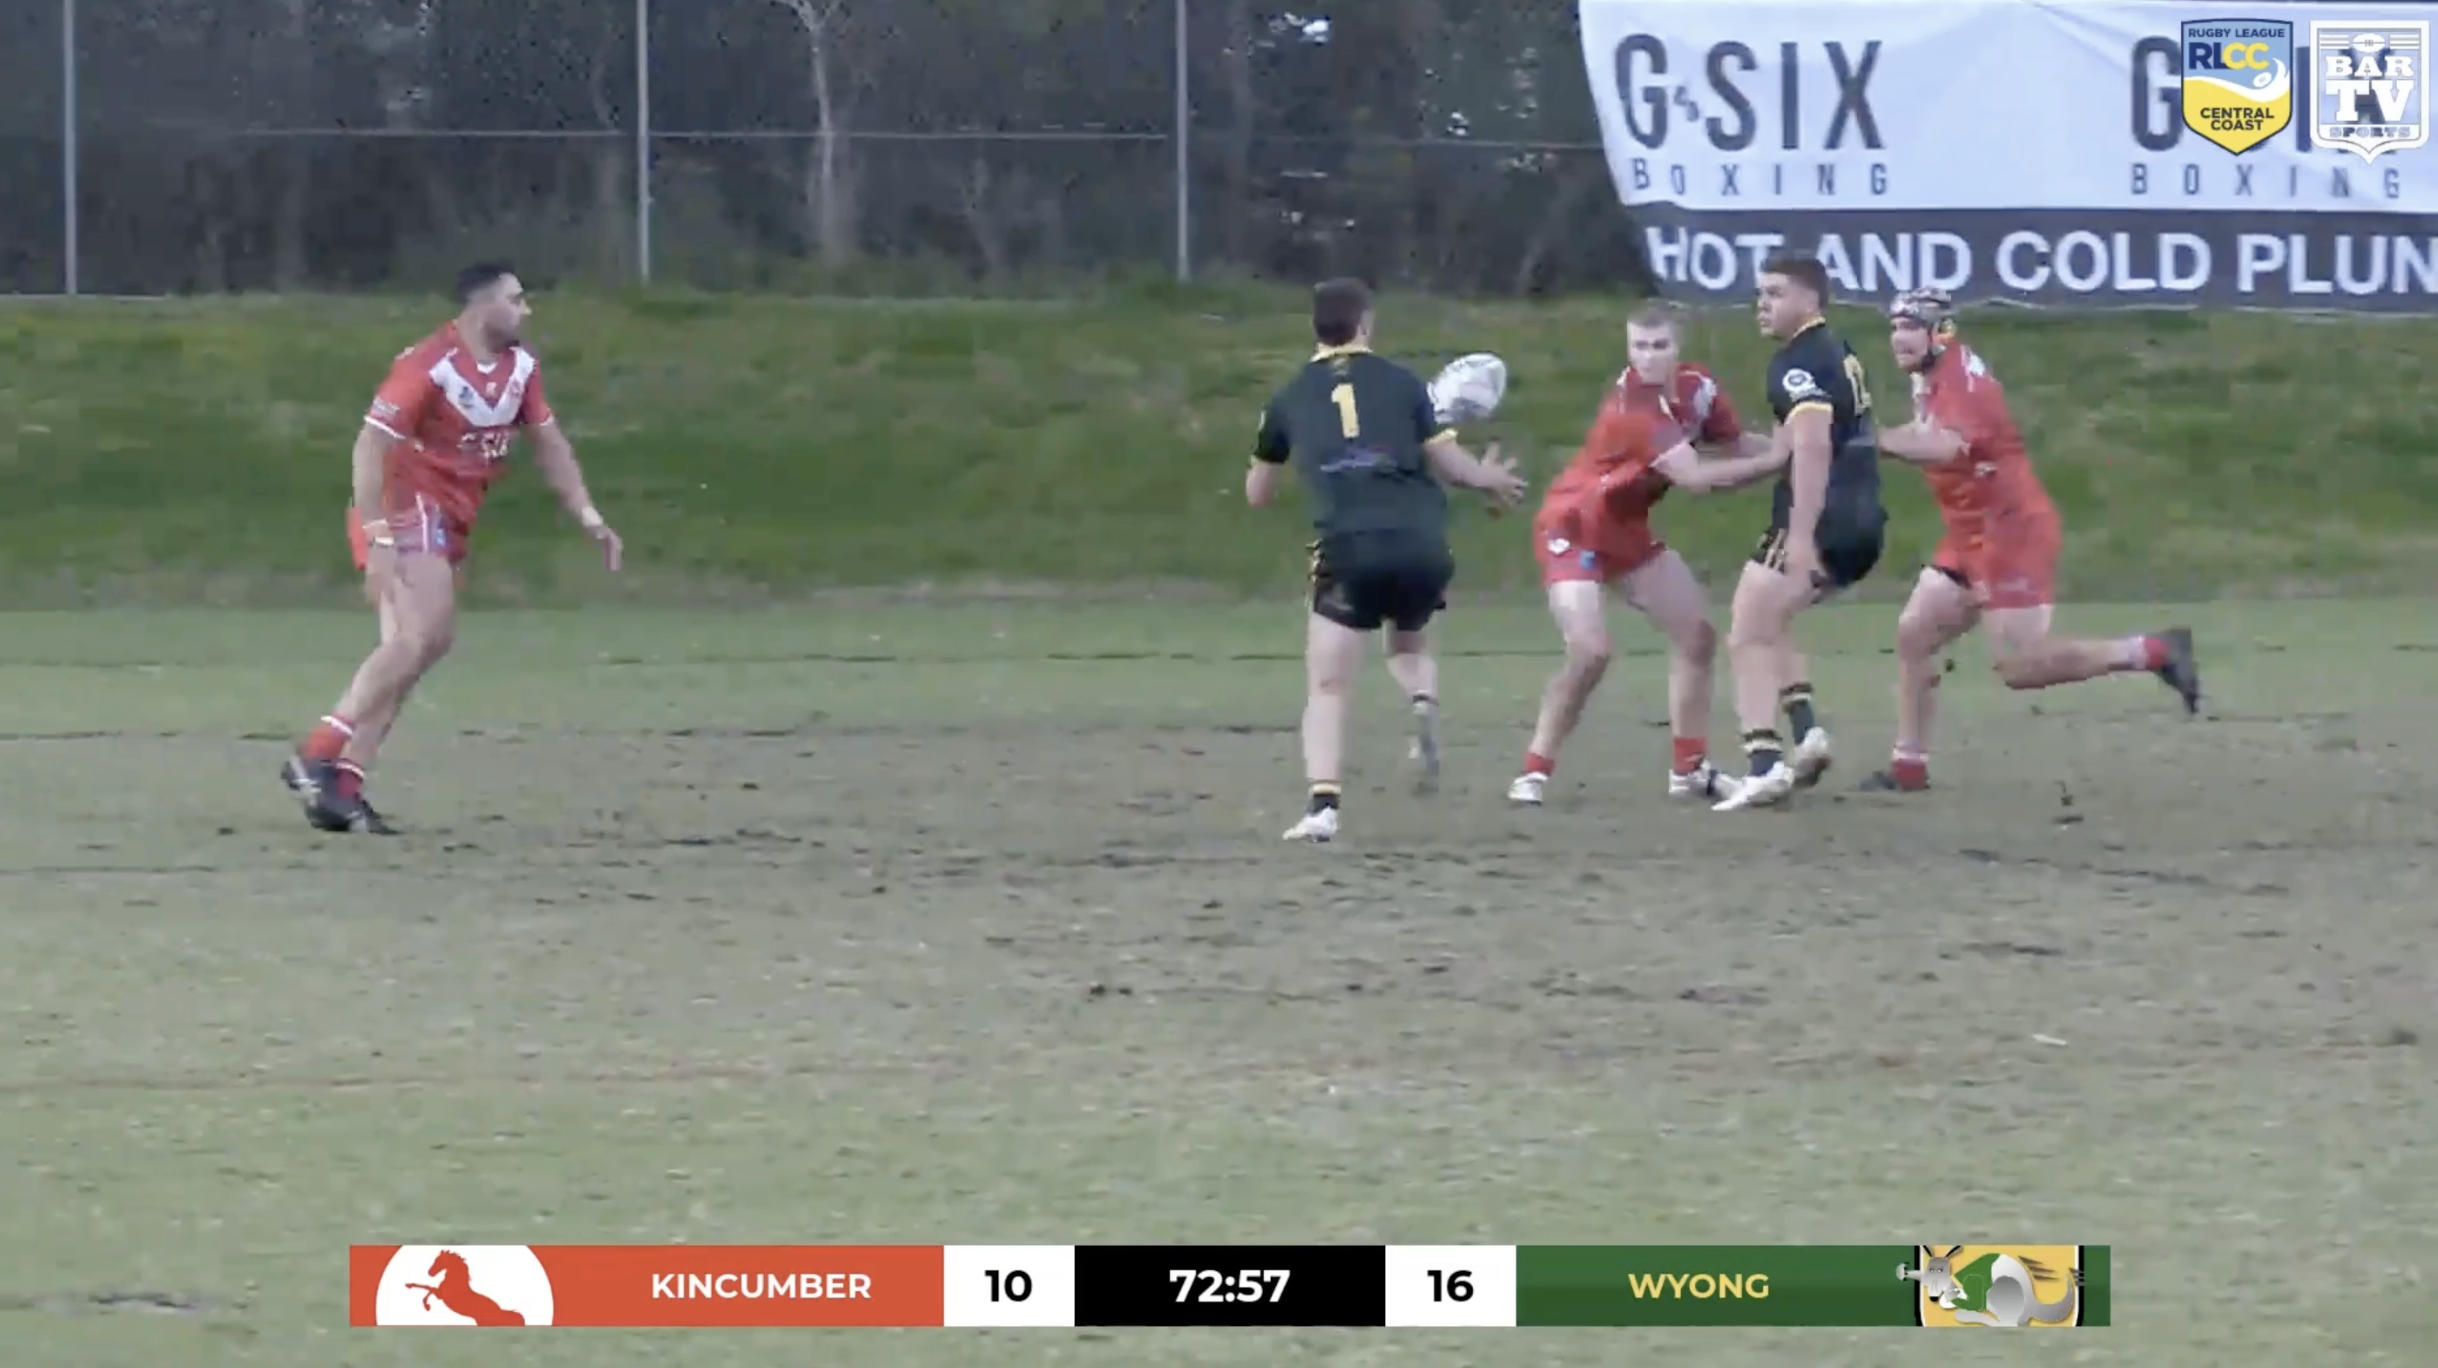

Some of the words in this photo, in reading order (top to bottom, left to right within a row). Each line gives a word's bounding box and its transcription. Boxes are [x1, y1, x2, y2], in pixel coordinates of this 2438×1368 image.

[1632, 158, 1887, 196] BOXING
[2131, 162, 2400, 199] BOXING
[1646, 226, 1785, 290] HOT
[1816, 232, 1972, 291] AND
[1997, 230, 2212, 291] COLD
[2237, 233, 2438, 295] PLUN
[1331, 383, 1360, 438] 1
